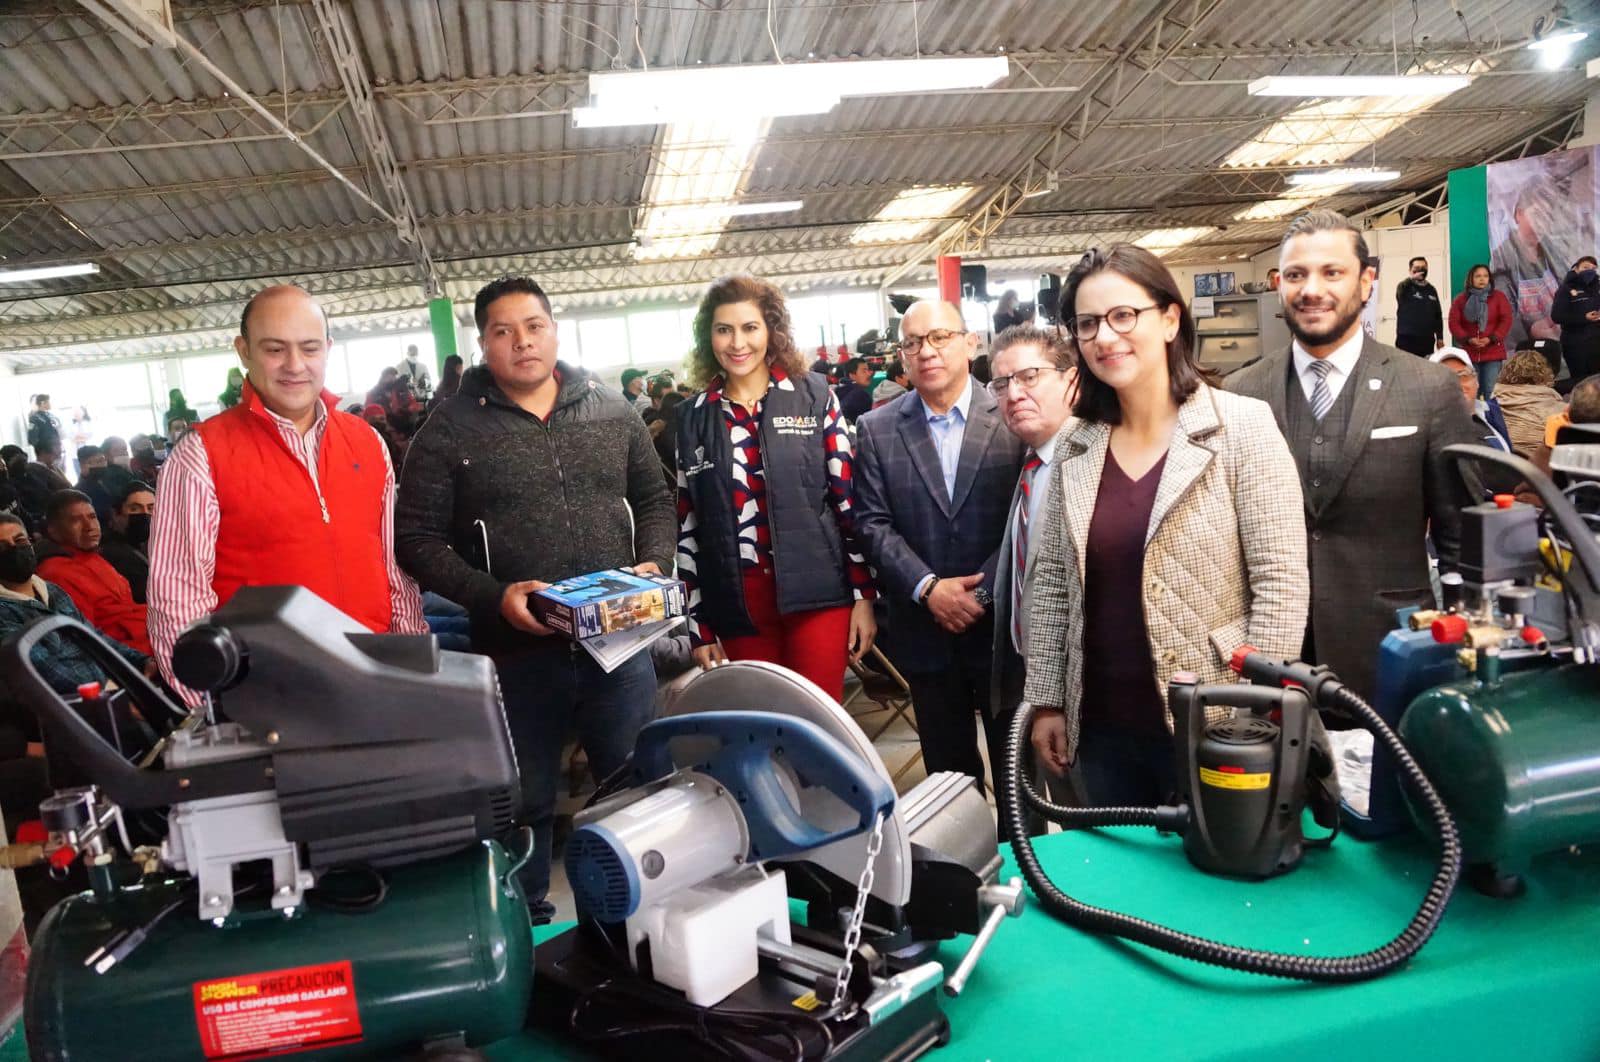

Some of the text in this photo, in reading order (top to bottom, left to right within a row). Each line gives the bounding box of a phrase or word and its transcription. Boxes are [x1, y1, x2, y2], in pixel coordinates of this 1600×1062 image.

[260, 969, 346, 993] PRECAUCION
[203, 986, 348, 1015] USO DE COMPRESOR OAKLAND
